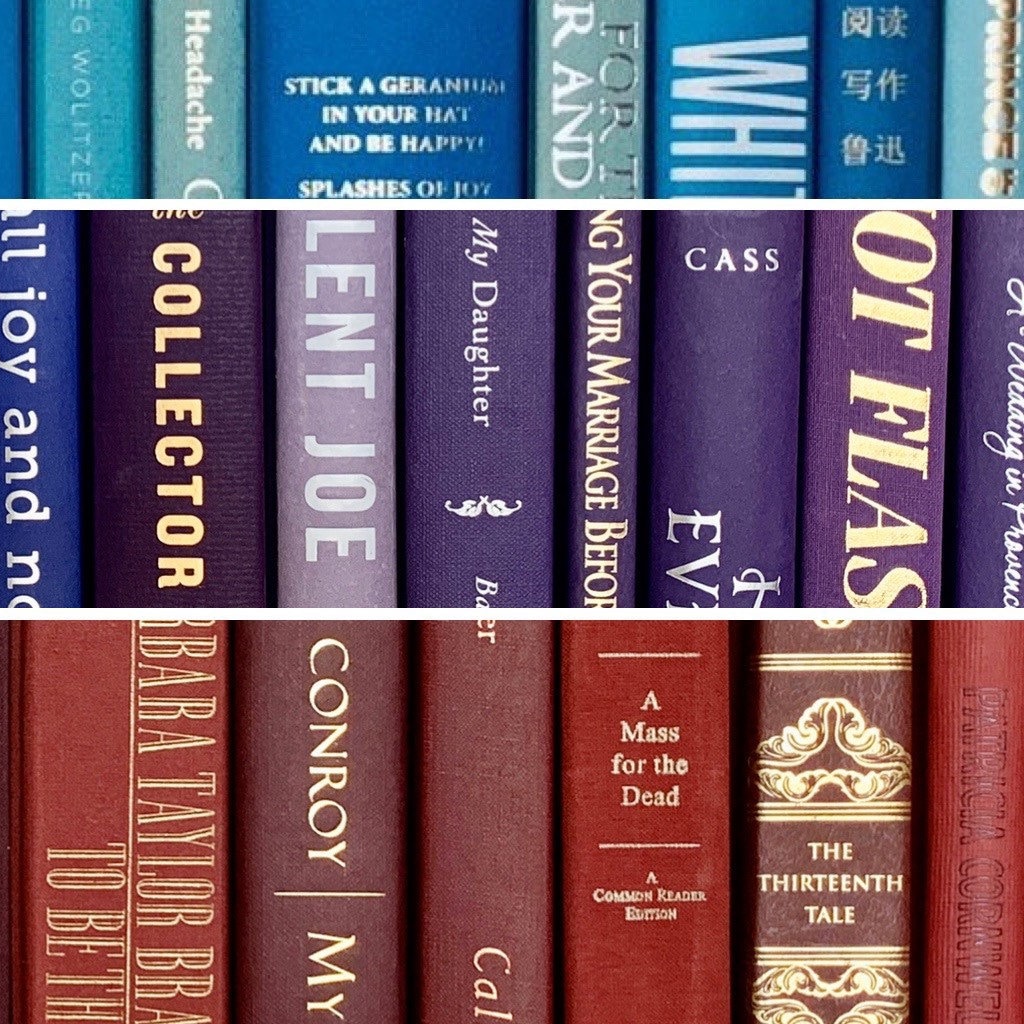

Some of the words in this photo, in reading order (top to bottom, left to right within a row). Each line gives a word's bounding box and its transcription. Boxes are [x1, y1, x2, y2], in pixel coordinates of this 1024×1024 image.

[840, 4, 909, 38] 阅读
[184, 8, 213, 152] Headache
[284, 75, 354, 96] STICK
[358, 75, 376, 96] A
[598, 20, 641, 145] FOR
[840, 68, 909, 102] 写作
[321, 105, 349, 125] IN
[353, 105, 419, 125] YOUR
[424, 106, 471, 125] HAT
[550, 60, 596, 189] AND
[308, 134, 362, 154] AND
[365, 134, 396, 154] BE
[840, 134, 907, 166] 鲁迅
[297, 178, 413, 199] SPLASHES
[465, 217, 500, 268] My
[684, 247, 781, 272] CASS
[304, 219, 377, 400] LENT
[586, 253, 633, 357] YOUR
[462, 279, 501, 428] Daughter
[151, 241, 206, 590] COLLECTOR
[584, 354, 633, 511] MARRIAGE
[3, 407, 51, 525] and
[303, 435, 377, 563] JOE
[639, 690, 661, 712] A
[620, 722, 681, 744] Mass
[307, 638, 351, 869] CONROY
[610, 753, 649, 776] for
[652, 753, 690, 776] the
[620, 784, 681, 808] Dead
[45, 841, 127, 890] TO
[135, 771, 217, 928] TAYLOR
[808, 842, 854, 861] THE
[645, 871, 658, 884] A
[759, 873, 904, 893] THIRTEENTH
[592, 887, 654, 903] COMMON
[624, 906, 678, 921] EDITION
[803, 905, 856, 925] TALE
[45, 908, 127, 958] BE
[306, 931, 357, 1020] MY
[473, 945, 514, 1022] Cal
